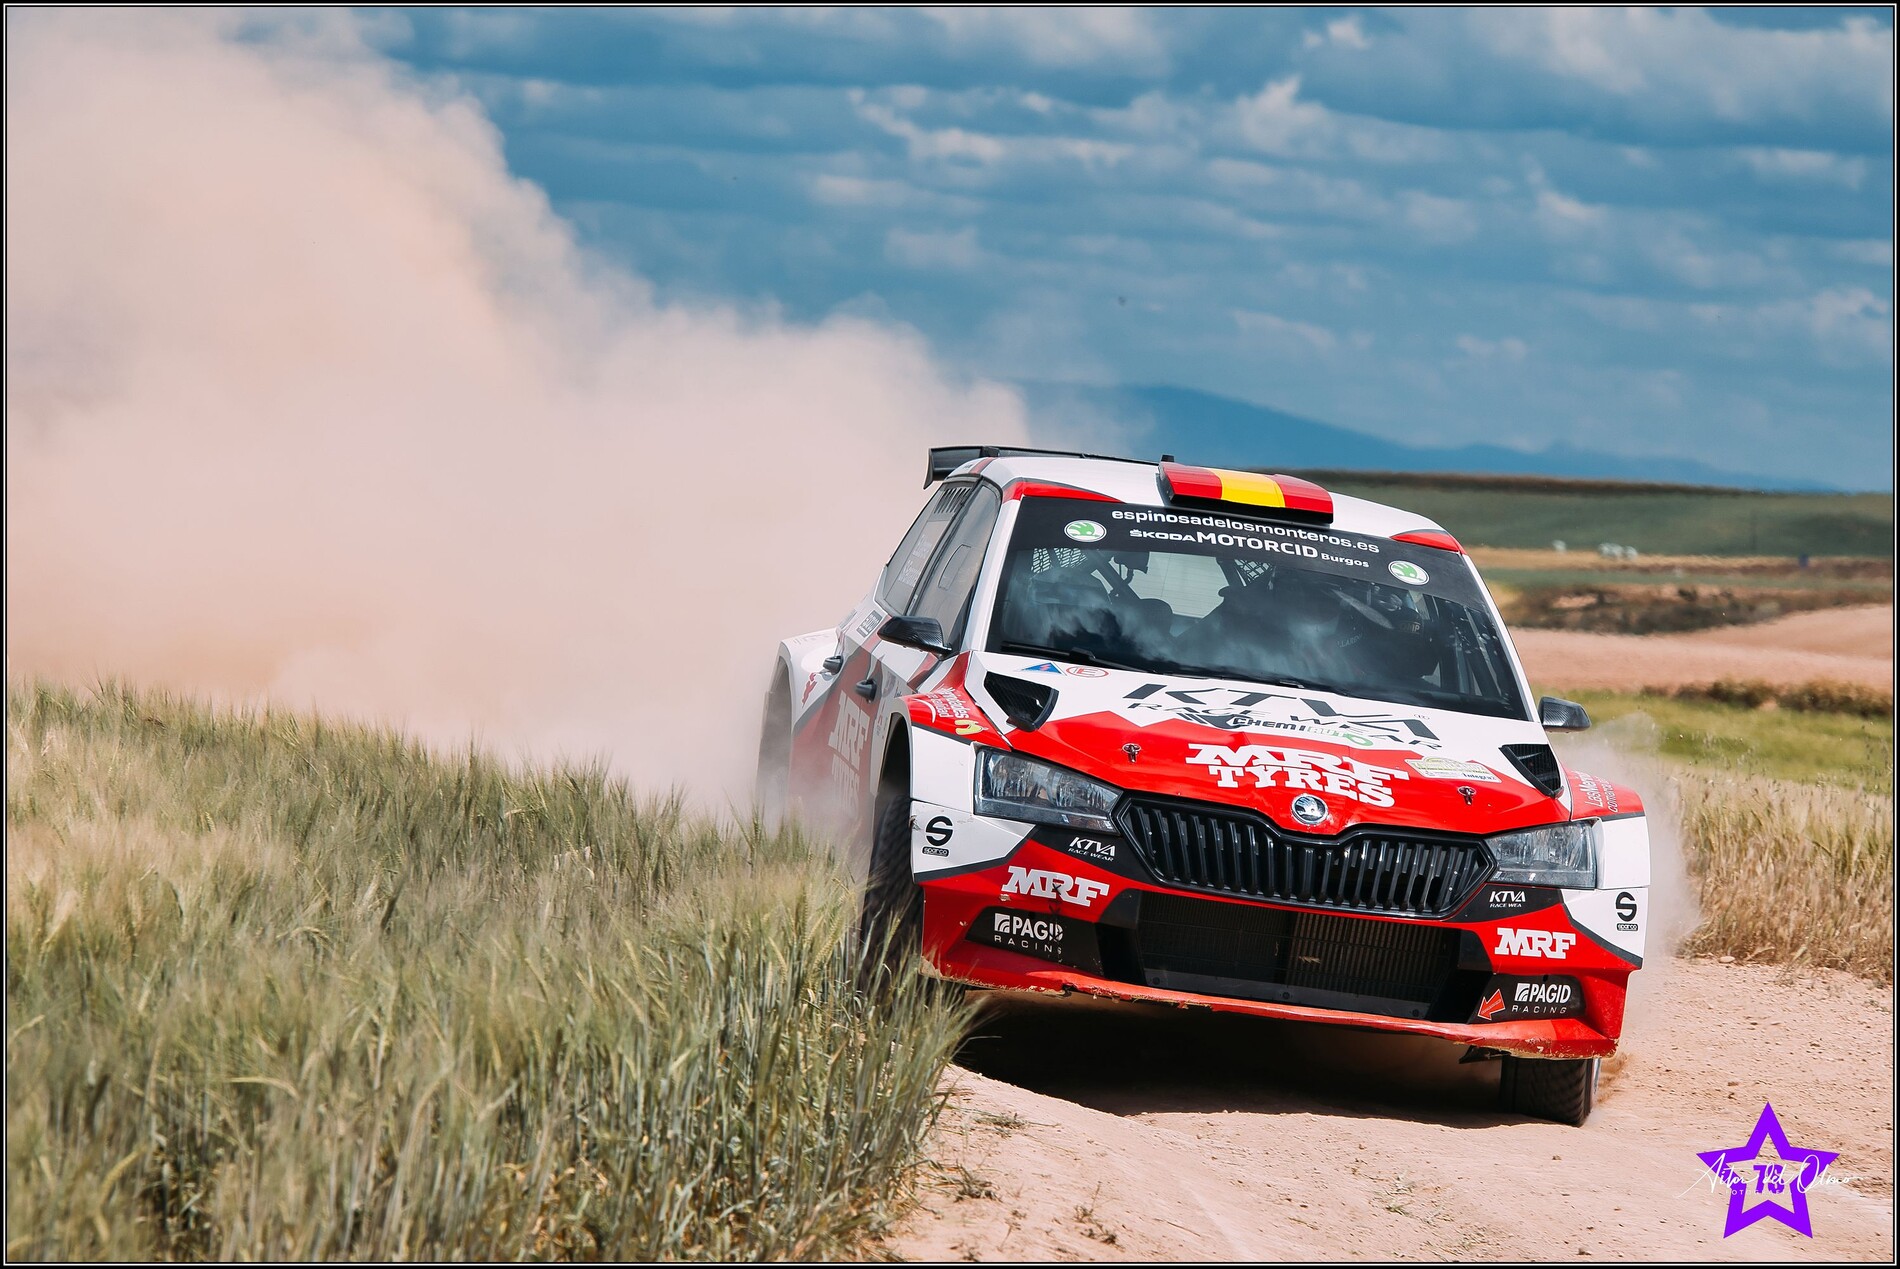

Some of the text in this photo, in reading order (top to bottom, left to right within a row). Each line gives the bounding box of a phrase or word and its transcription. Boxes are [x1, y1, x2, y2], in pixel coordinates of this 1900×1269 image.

[1111, 509, 1380, 553] espinosadelosmonteros.es
[1196, 531, 1319, 558] MOTORCID
[1321, 552, 1370, 568] Burgos
[1122, 683, 1440, 740] KTVA
[1128, 703, 1442, 750] RACE WEAR
[1185, 743, 1410, 786] MRF
[1208, 765, 1395, 807] TYRES
[923, 847, 949, 857] sparco
[1068, 847, 1114, 862] RACE WEAR
[1069, 836, 1115, 857] KTVA
[1001, 865, 1110, 907] MRF
[1489, 890, 1526, 903] KTVA
[1013, 916, 1063, 942] PAGID
[1494, 927, 1576, 959] MRF
[1511, 1004, 1567, 1014] RACING
[1529, 983, 1571, 1003] PAGID
